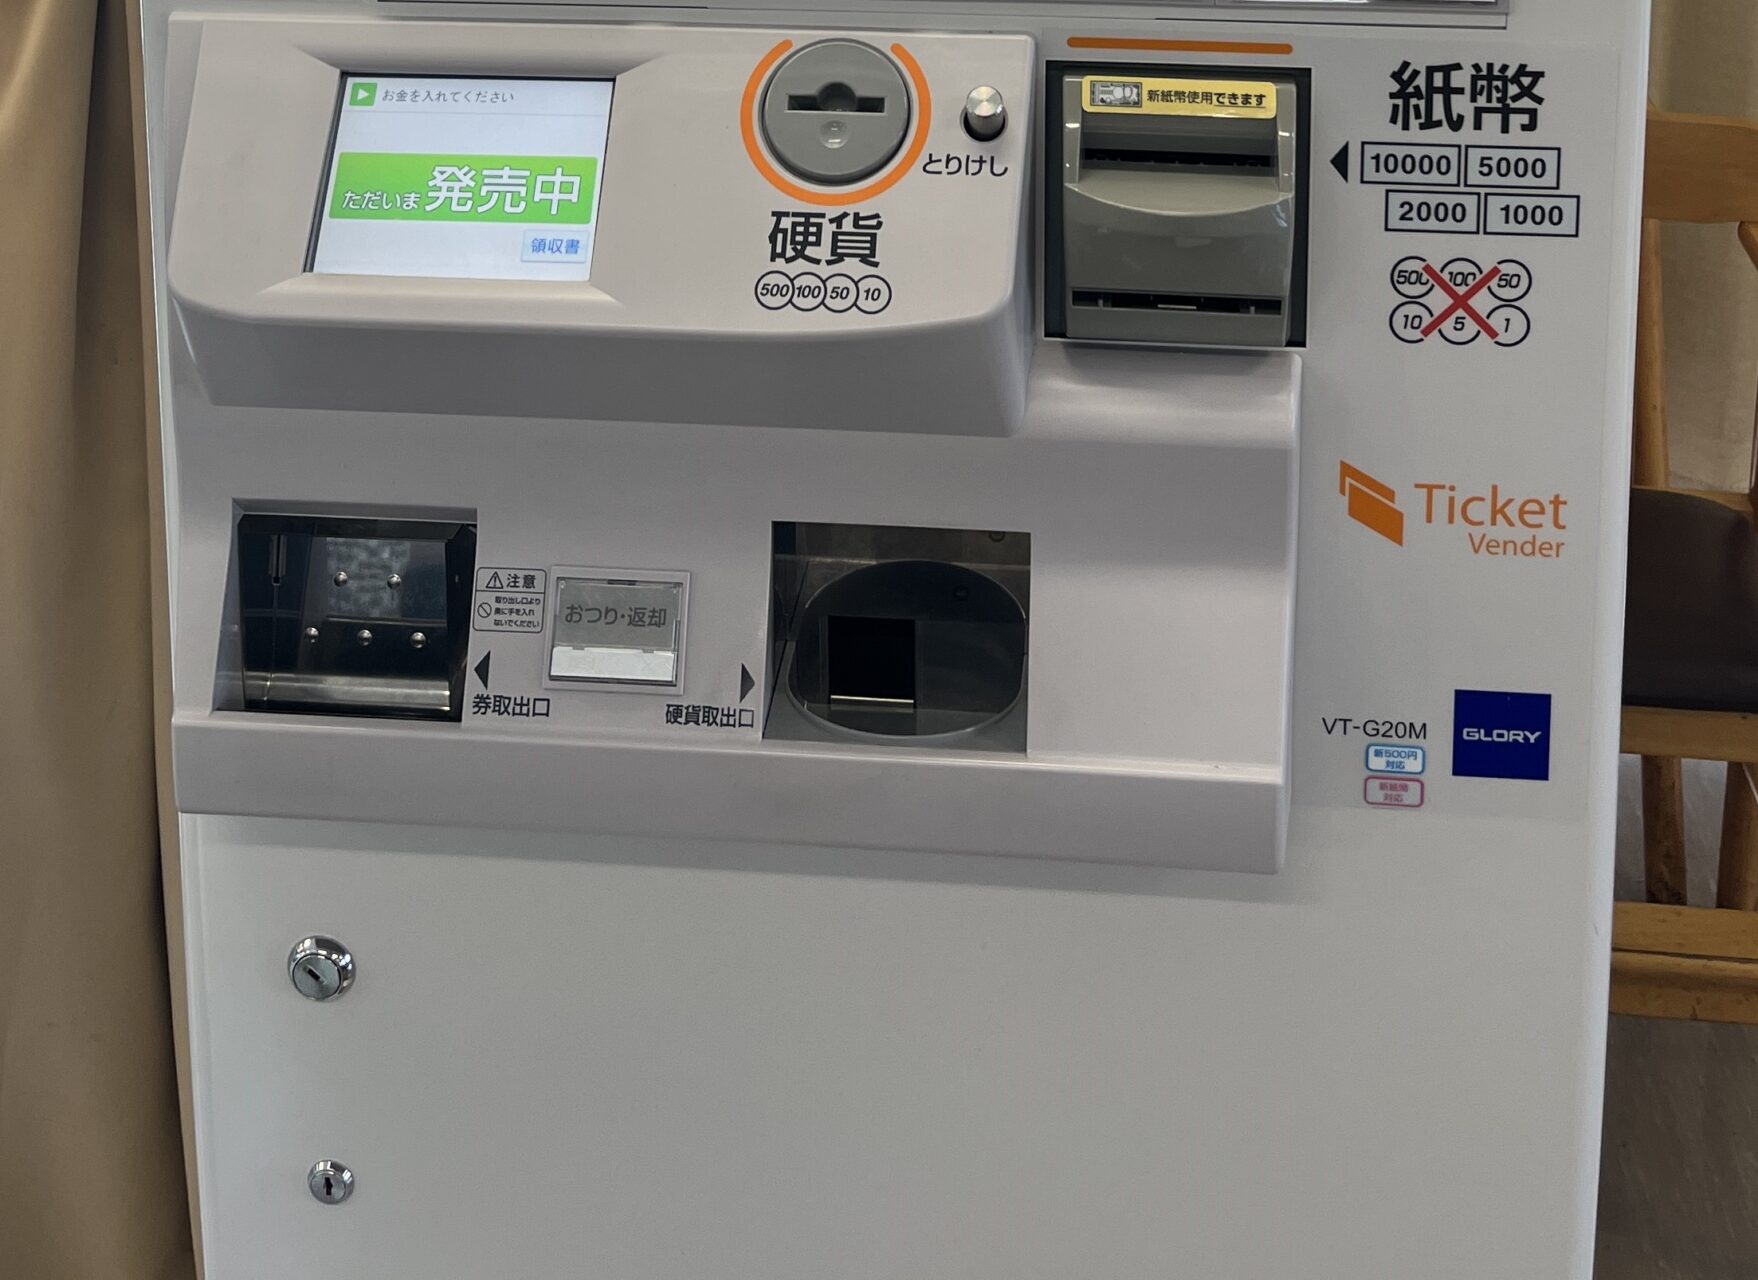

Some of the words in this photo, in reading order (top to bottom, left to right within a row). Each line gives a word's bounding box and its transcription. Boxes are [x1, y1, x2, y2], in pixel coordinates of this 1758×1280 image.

[382, 88, 515, 104] お金を入れてください
[1146, 88, 1267, 107] 新紙幣使用できます
[1389, 60, 1546, 134] 紙幣
[922, 152, 1009, 177] とりけし
[1370, 153, 1452, 176] 10000
[1478, 157, 1547, 179] 5000
[1399, 201, 1467, 223] 2000
[1500, 204, 1563, 226] 1000
[530, 238, 581, 256] 領収書
[768, 210, 884, 269] 硬貨
[759, 283, 790, 298] 500
[796, 284, 822, 300] 100
[829, 286, 850, 301] 50
[863, 287, 881, 302] 10
[1497, 273, 1521, 289] 50
[1402, 314, 1423, 331] 10
[1453, 316, 1466, 332] 5
[1414, 483, 1568, 530] Ticket
[1468, 533, 1566, 558] Vender
[506, 573, 536, 589] 注意
[565, 604, 669, 628] おつり・返却
[472, 693, 550, 718] 券取出口
[665, 704, 755, 729] 硬貨取出口
[1322, 717, 1428, 740] VT-G20M
[1463, 727, 1543, 744] GLORY
